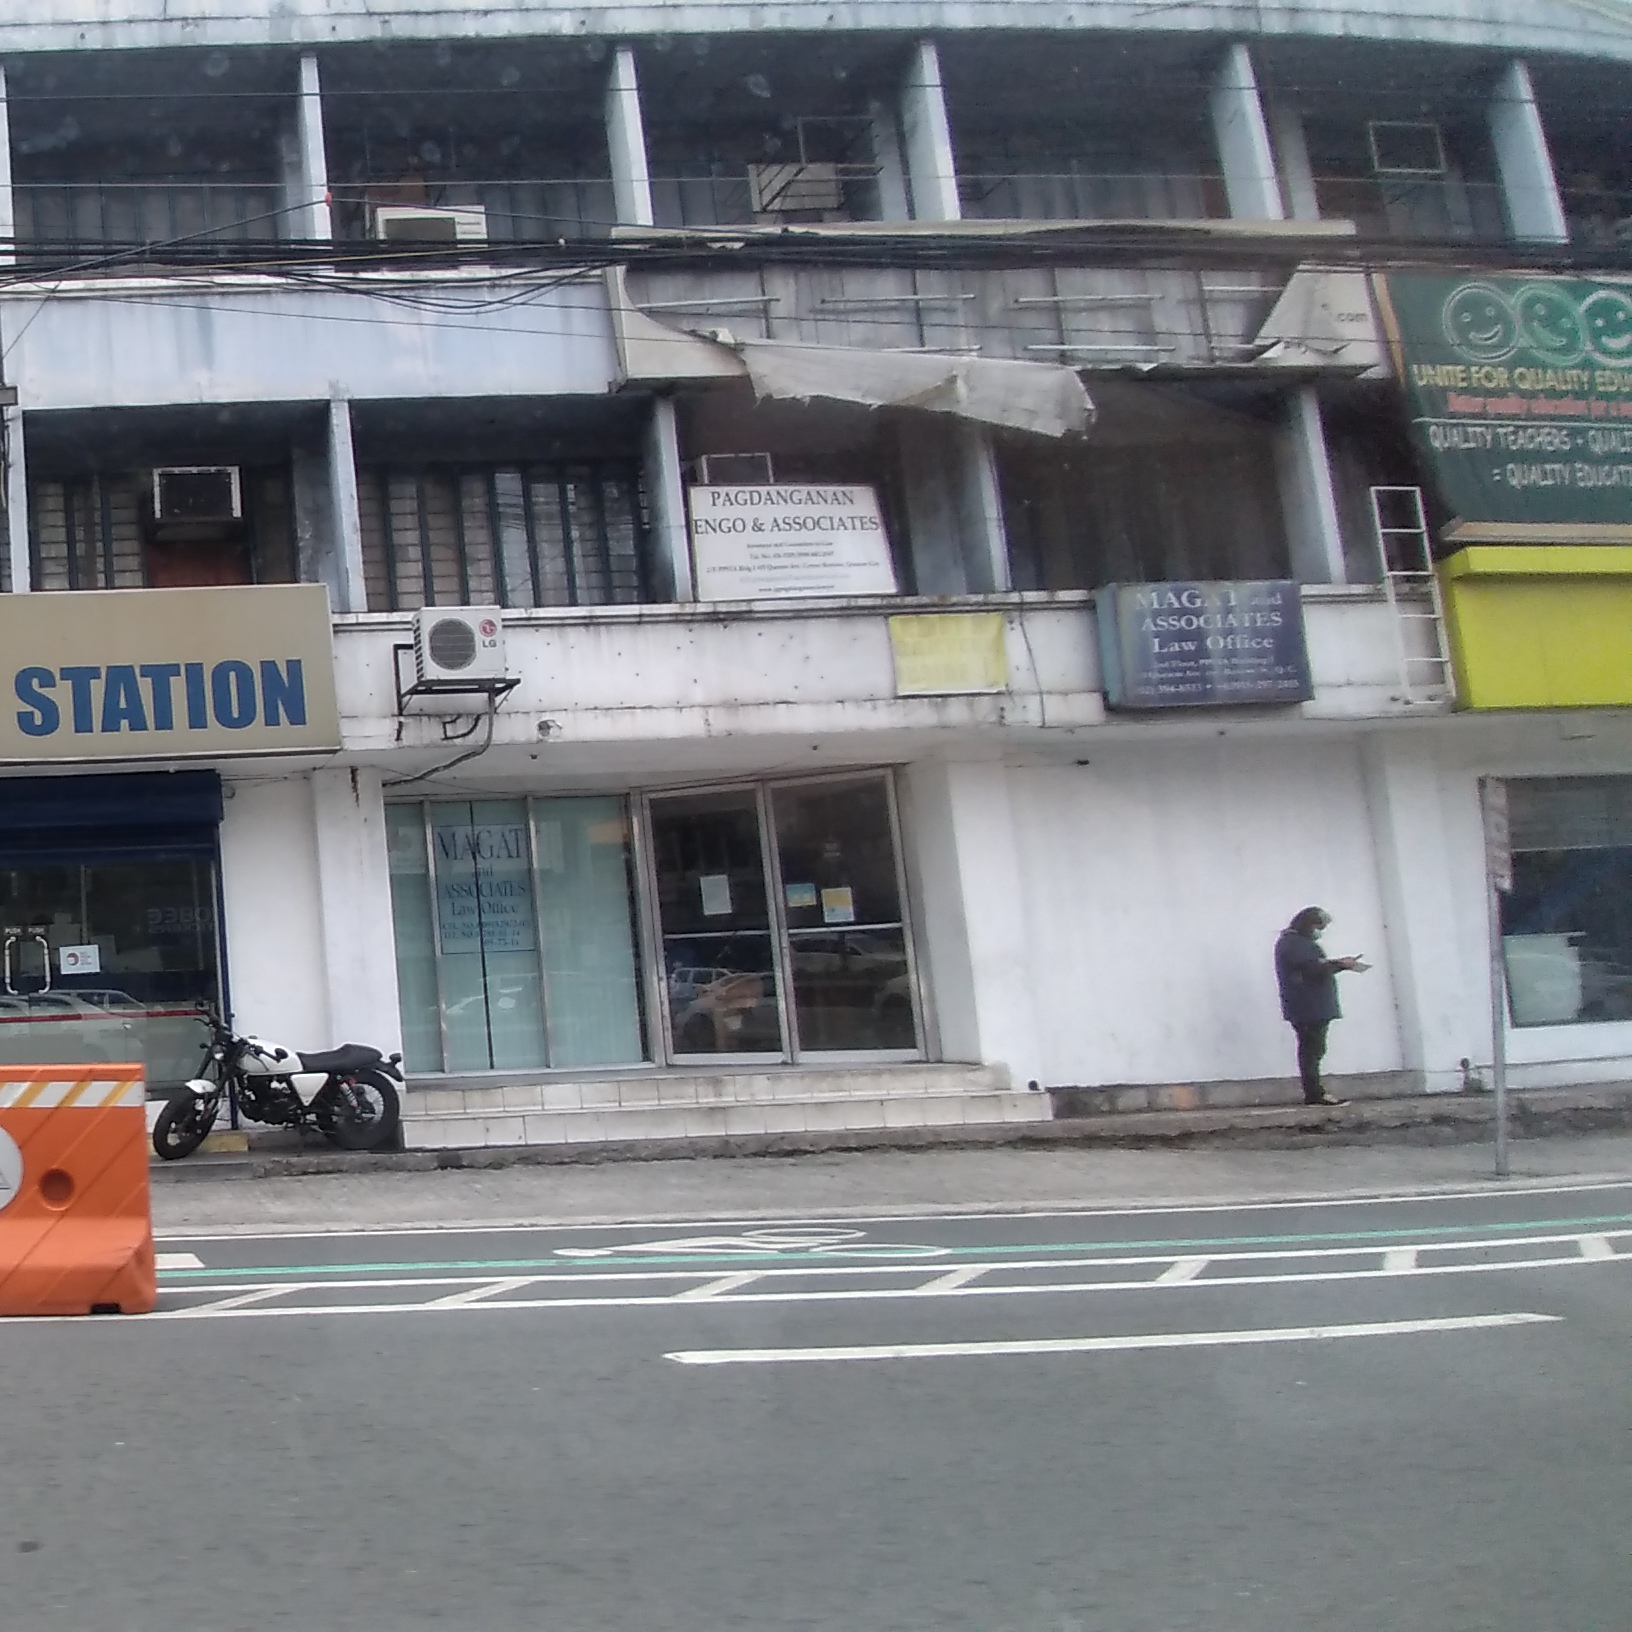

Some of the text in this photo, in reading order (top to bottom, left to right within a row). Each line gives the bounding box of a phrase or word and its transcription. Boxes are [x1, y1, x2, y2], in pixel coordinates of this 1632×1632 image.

[1412, 364, 1468, 388] UNITE
[1470, 365, 1510, 388] FOR
[1514, 366, 1590, 391] QUALITY
[1429, 424, 1492, 451] QUALITY
[1506, 463, 1570, 489] QUALITY
[710, 490, 855, 507] PAGDANGANAN
[751, 517, 766, 533] &
[769, 516, 879, 533] ASSOCIATES
[1135, 589, 1237, 610] MAGT
[1142, 611, 1283, 631] ASSOCIATES
[482, 639, 498, 648] LG
[1152, 633, 1275, 653] Law Office
[14, 659, 308, 738] STATION
[437, 828, 524, 861] MAGAT
[444, 880, 527, 900] ASSOCIATES
[451, 901, 476, 916] Law
